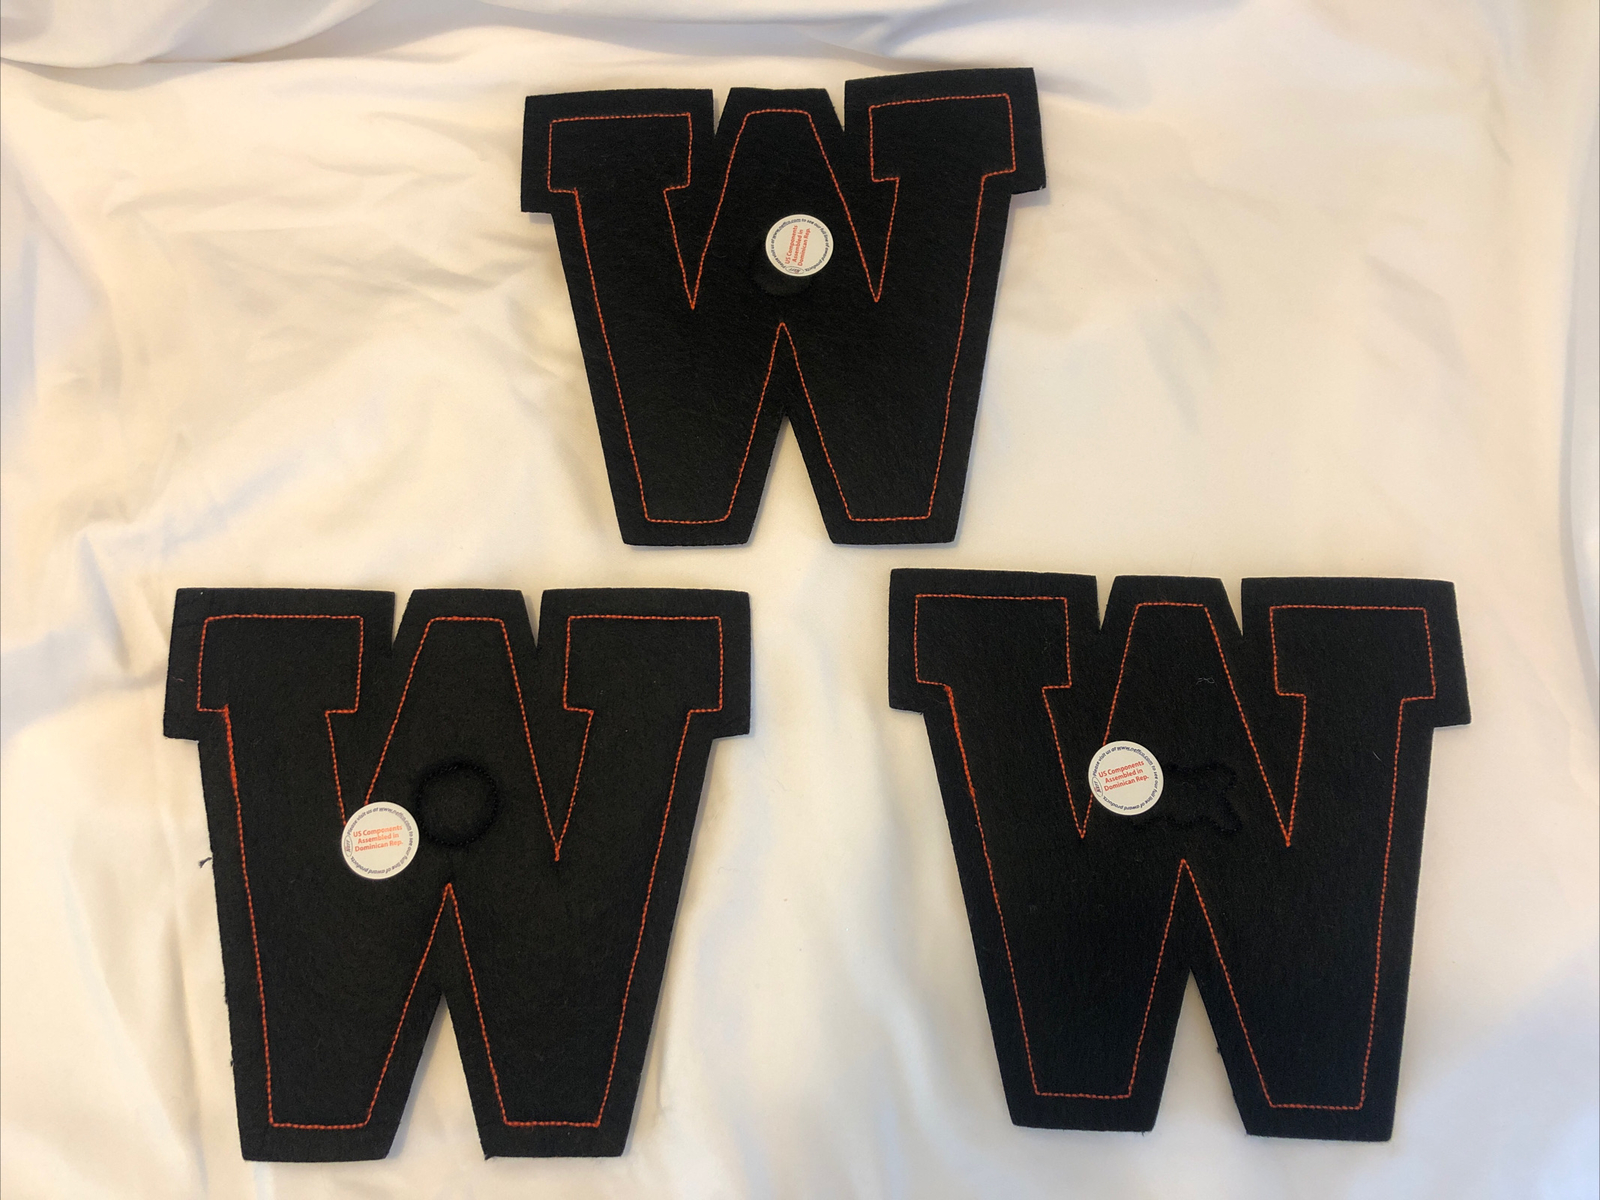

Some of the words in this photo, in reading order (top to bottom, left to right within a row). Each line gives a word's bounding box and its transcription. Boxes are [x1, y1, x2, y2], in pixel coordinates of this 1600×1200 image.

[1108, 761, 1144, 775] Components
[1105, 770, 1136, 783] Assembled
[1104, 779, 1135, 791] Dominican
[363, 825, 402, 835] Components
[358, 833, 391, 844] Assembled
[355, 842, 388, 851] Dominican
